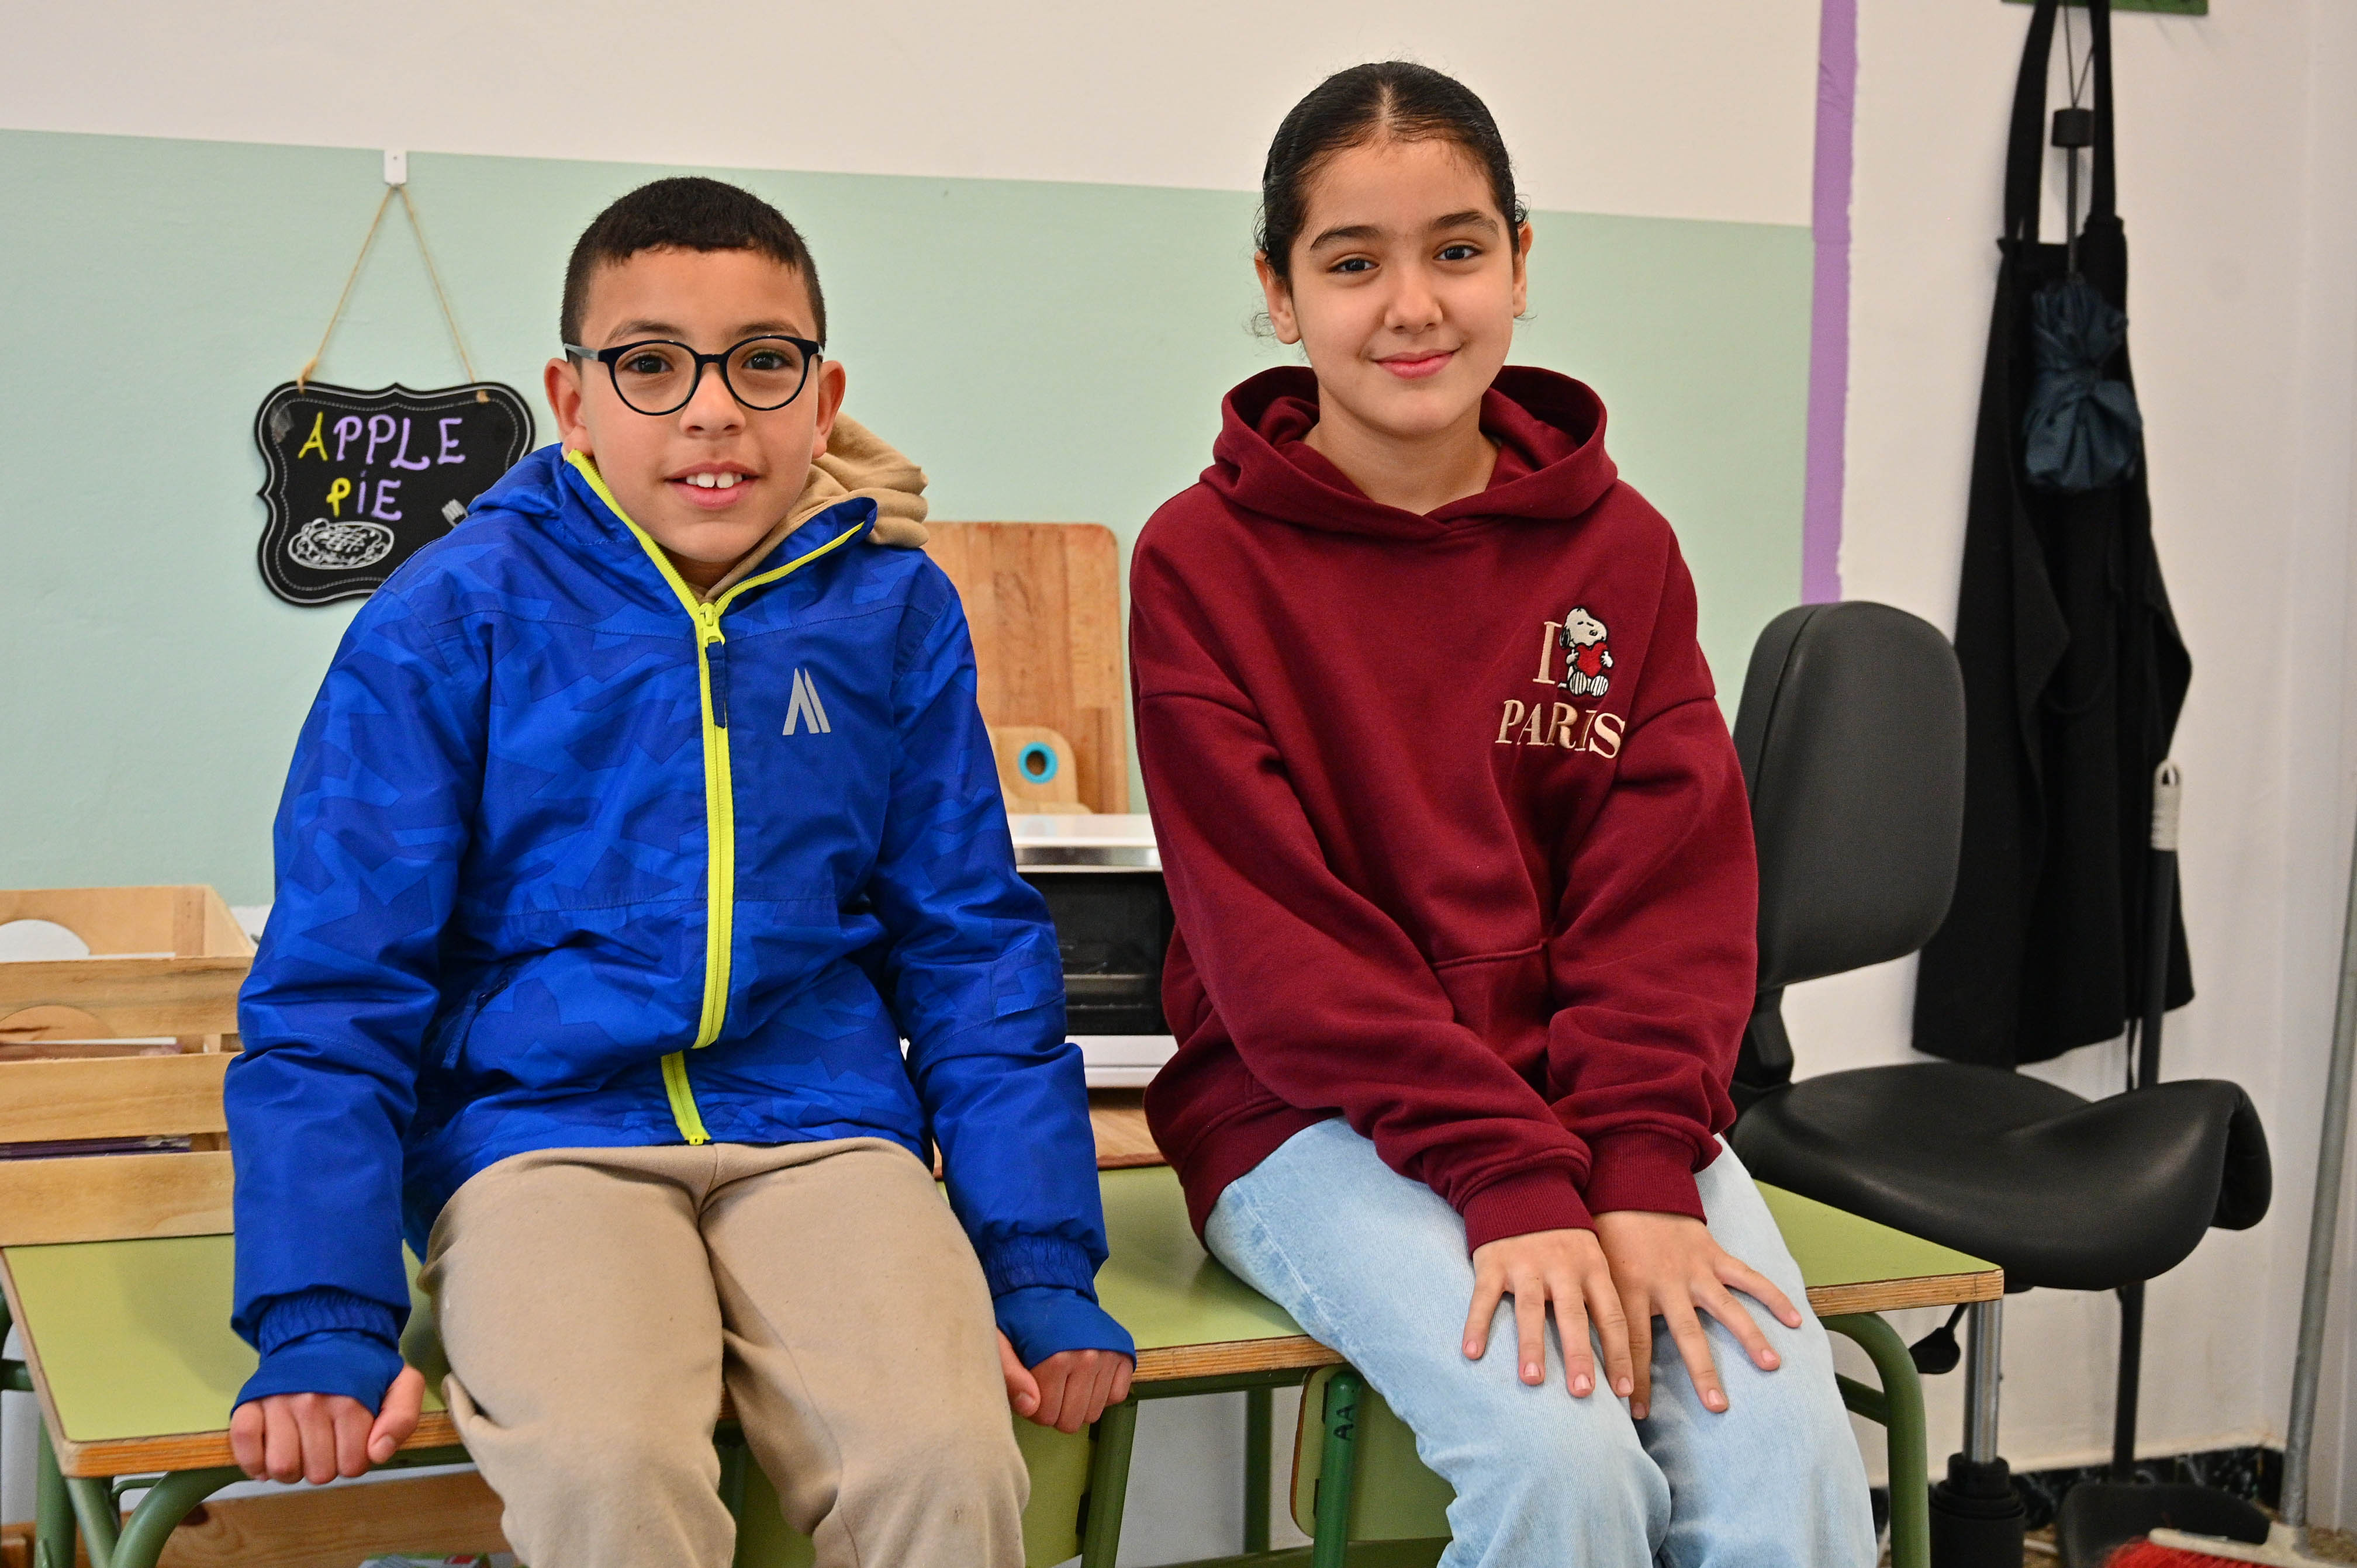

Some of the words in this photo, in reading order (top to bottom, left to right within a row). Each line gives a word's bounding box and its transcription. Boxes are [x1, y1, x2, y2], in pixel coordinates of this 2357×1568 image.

[298, 411, 466, 471] APPLE
[1532, 621, 1563, 685] I
[1494, 699, 1626, 759] PARIS
